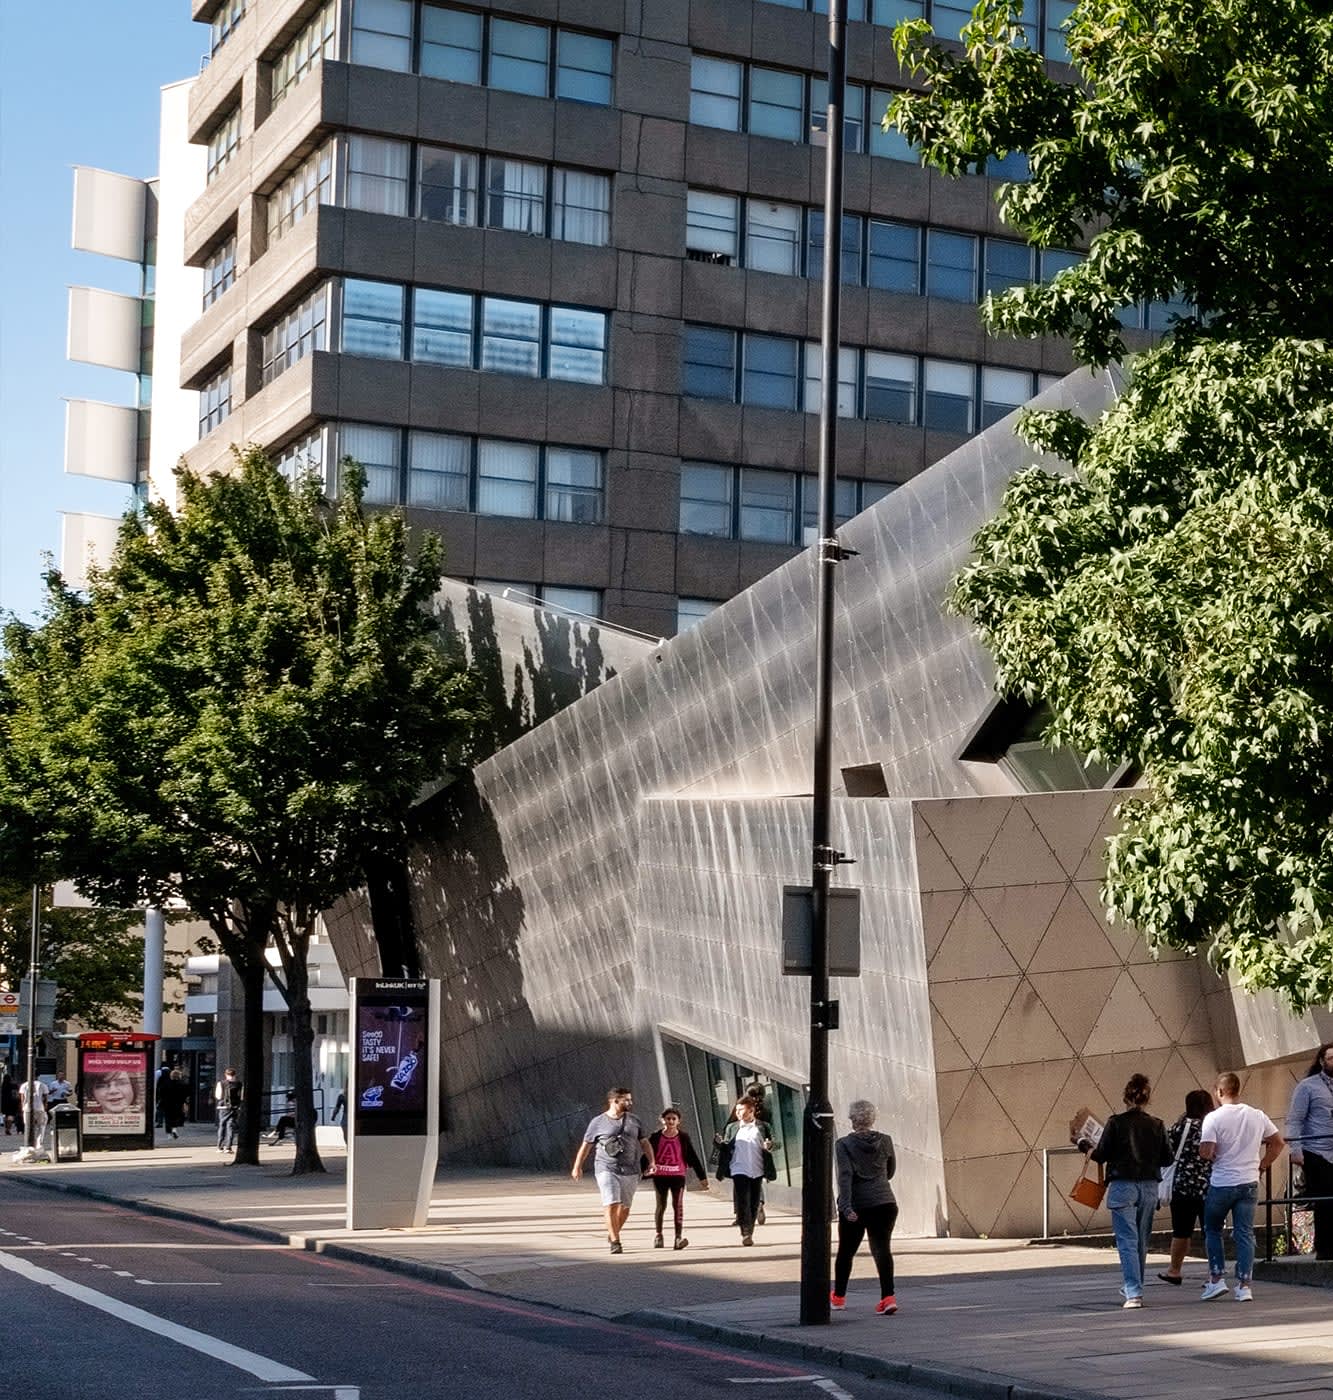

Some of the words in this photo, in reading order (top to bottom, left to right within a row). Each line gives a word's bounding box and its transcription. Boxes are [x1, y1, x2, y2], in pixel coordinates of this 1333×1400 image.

[362, 1038, 381, 1046] TASTY
[362, 1046, 374, 1054] IT'S
[376, 1046, 396, 1054] NEVER
